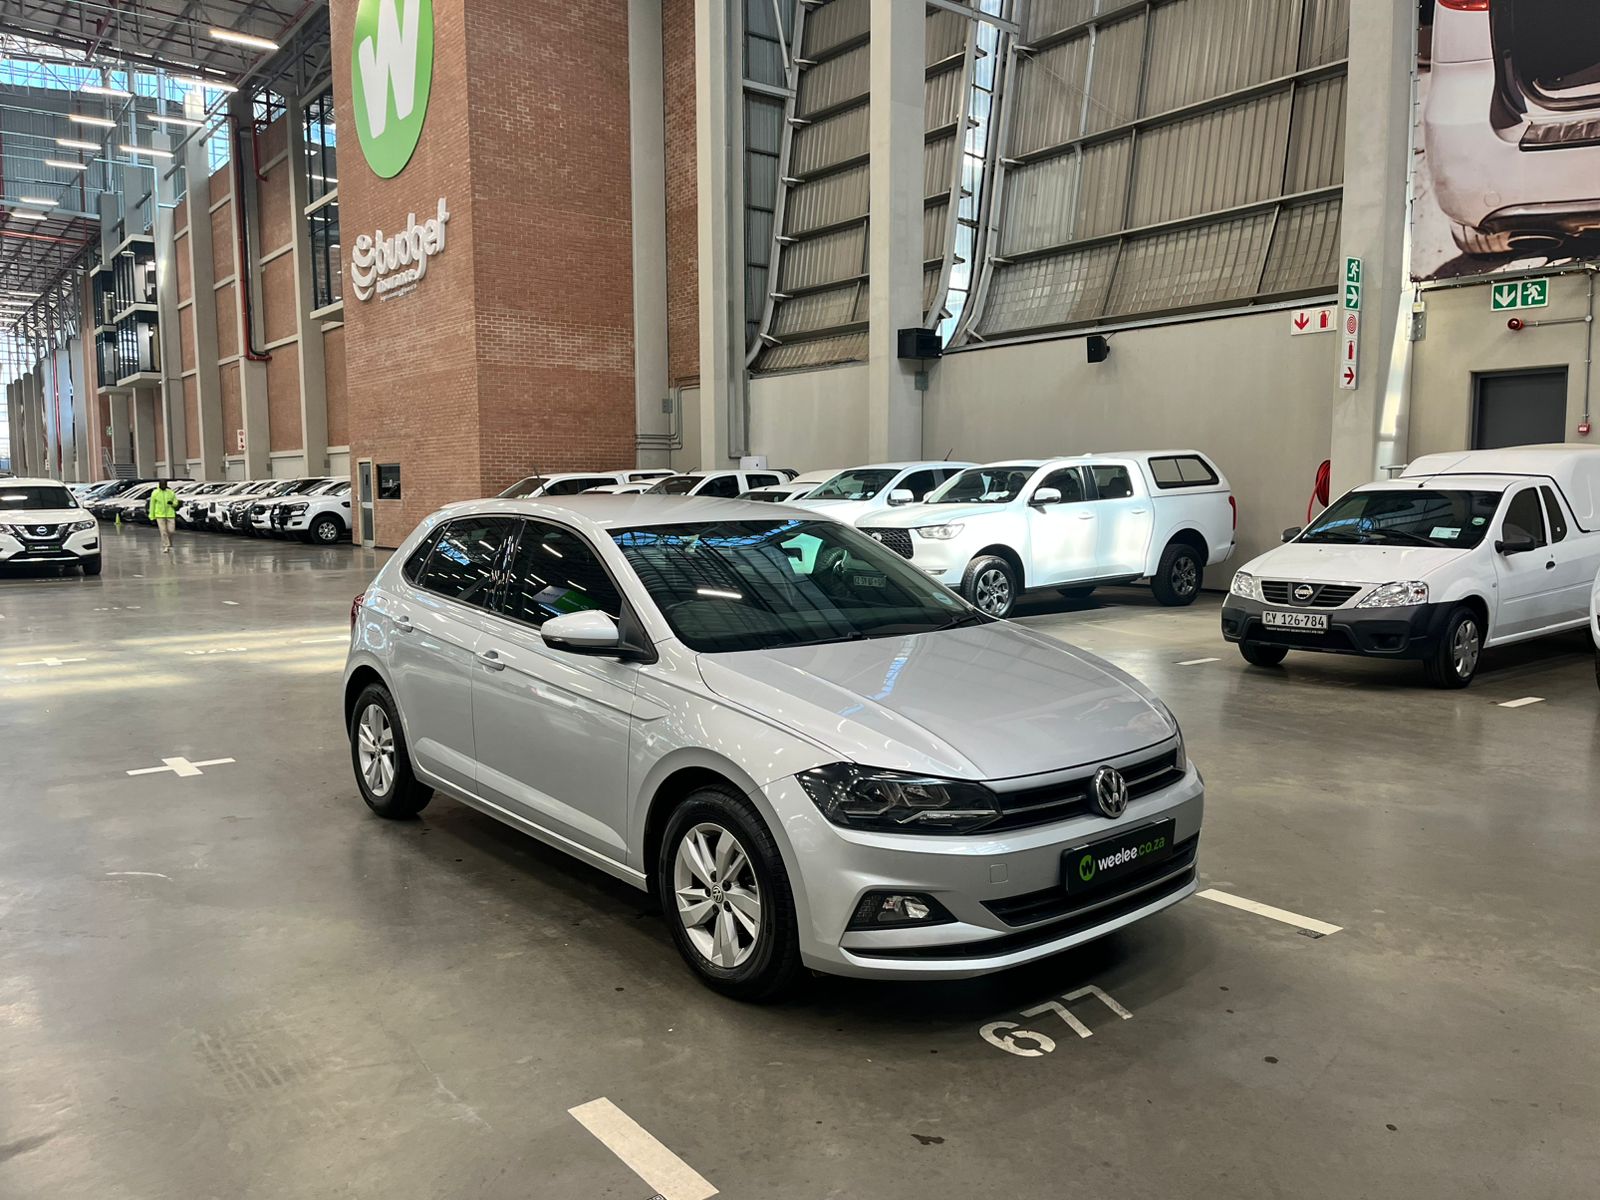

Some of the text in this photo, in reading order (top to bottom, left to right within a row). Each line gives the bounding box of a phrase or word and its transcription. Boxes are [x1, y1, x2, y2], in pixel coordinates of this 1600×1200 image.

[375, 197, 450, 280] budget
[1265, 612, 1325, 628] CY 126-784
[1098, 837, 1166, 871] weelee.co.za
[979, 984, 1134, 1057] 677
